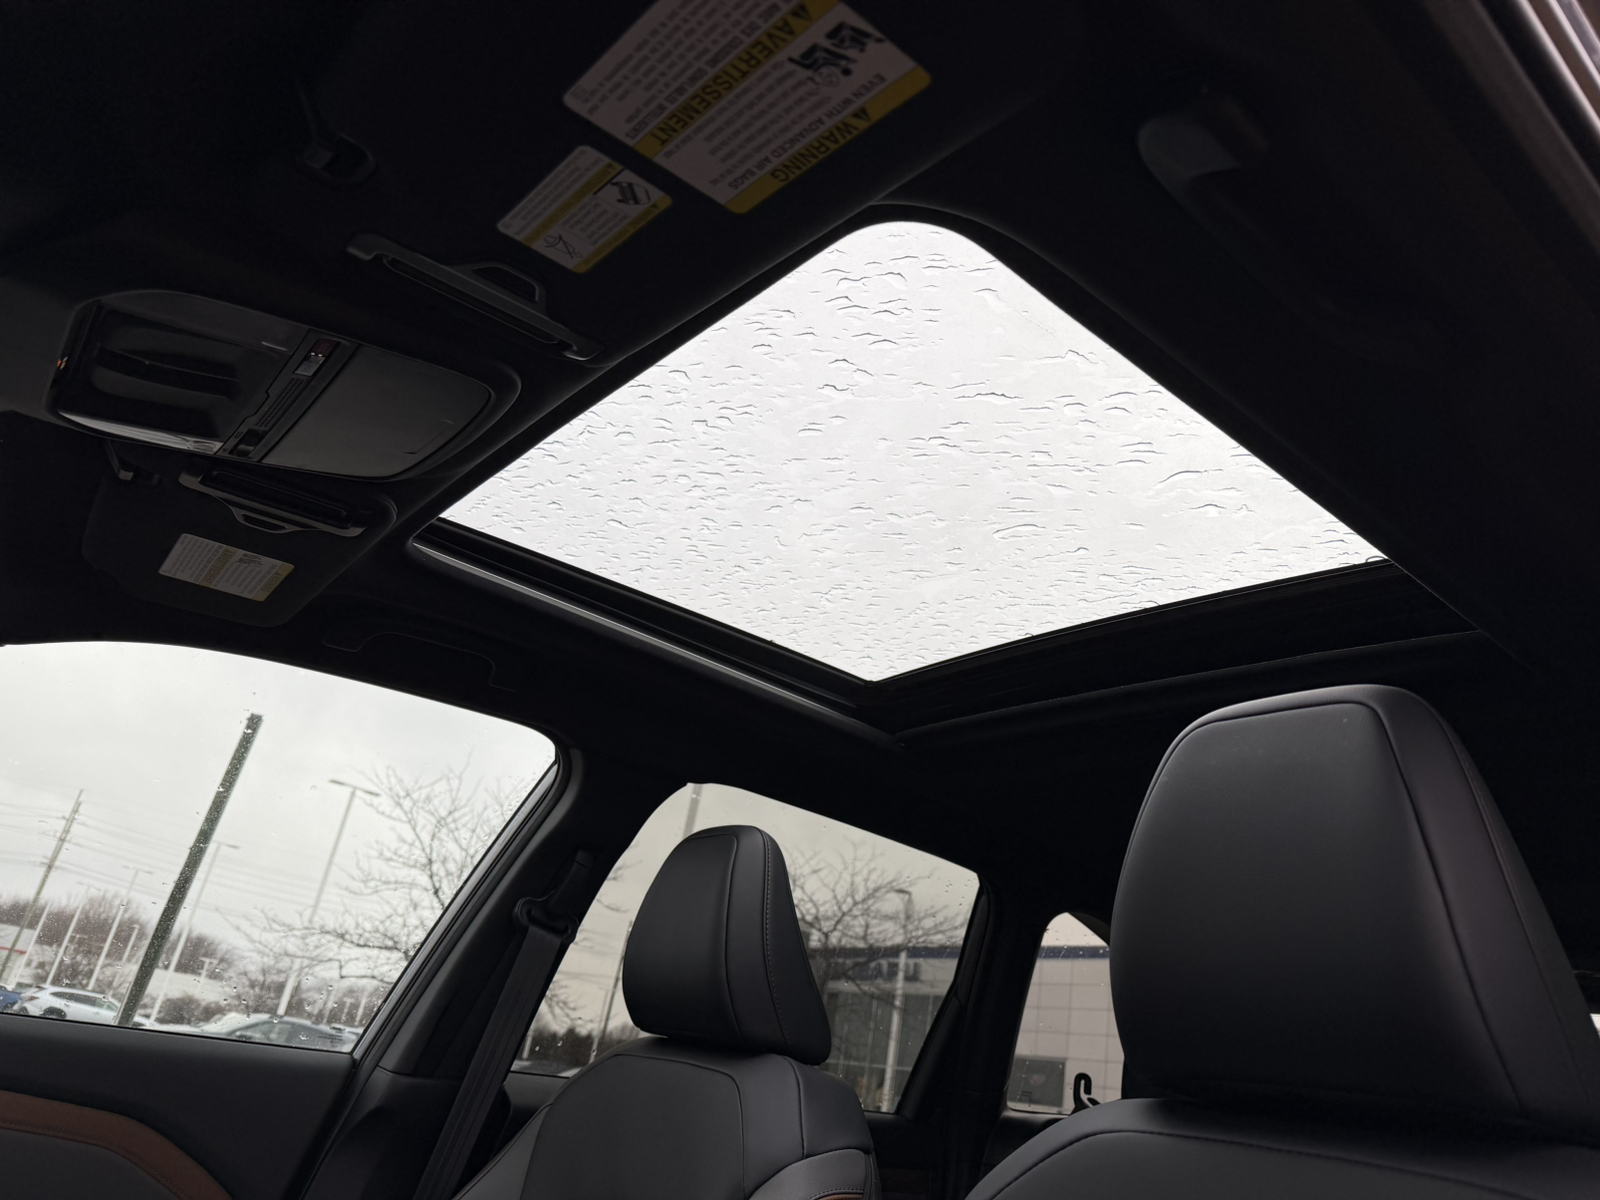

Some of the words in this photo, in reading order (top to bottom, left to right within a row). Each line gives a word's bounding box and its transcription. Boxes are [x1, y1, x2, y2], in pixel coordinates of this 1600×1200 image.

[648, 17, 794, 146] AVERTISSEMENT
[850, 72, 886, 100] EVEN
[822, 96, 854, 120] WITH
[768, 120, 859, 183] WARNING
[769, 116, 826, 159] ADVANCED
[751, 155, 773, 172] AIR
[726, 168, 757, 190] BAGS
